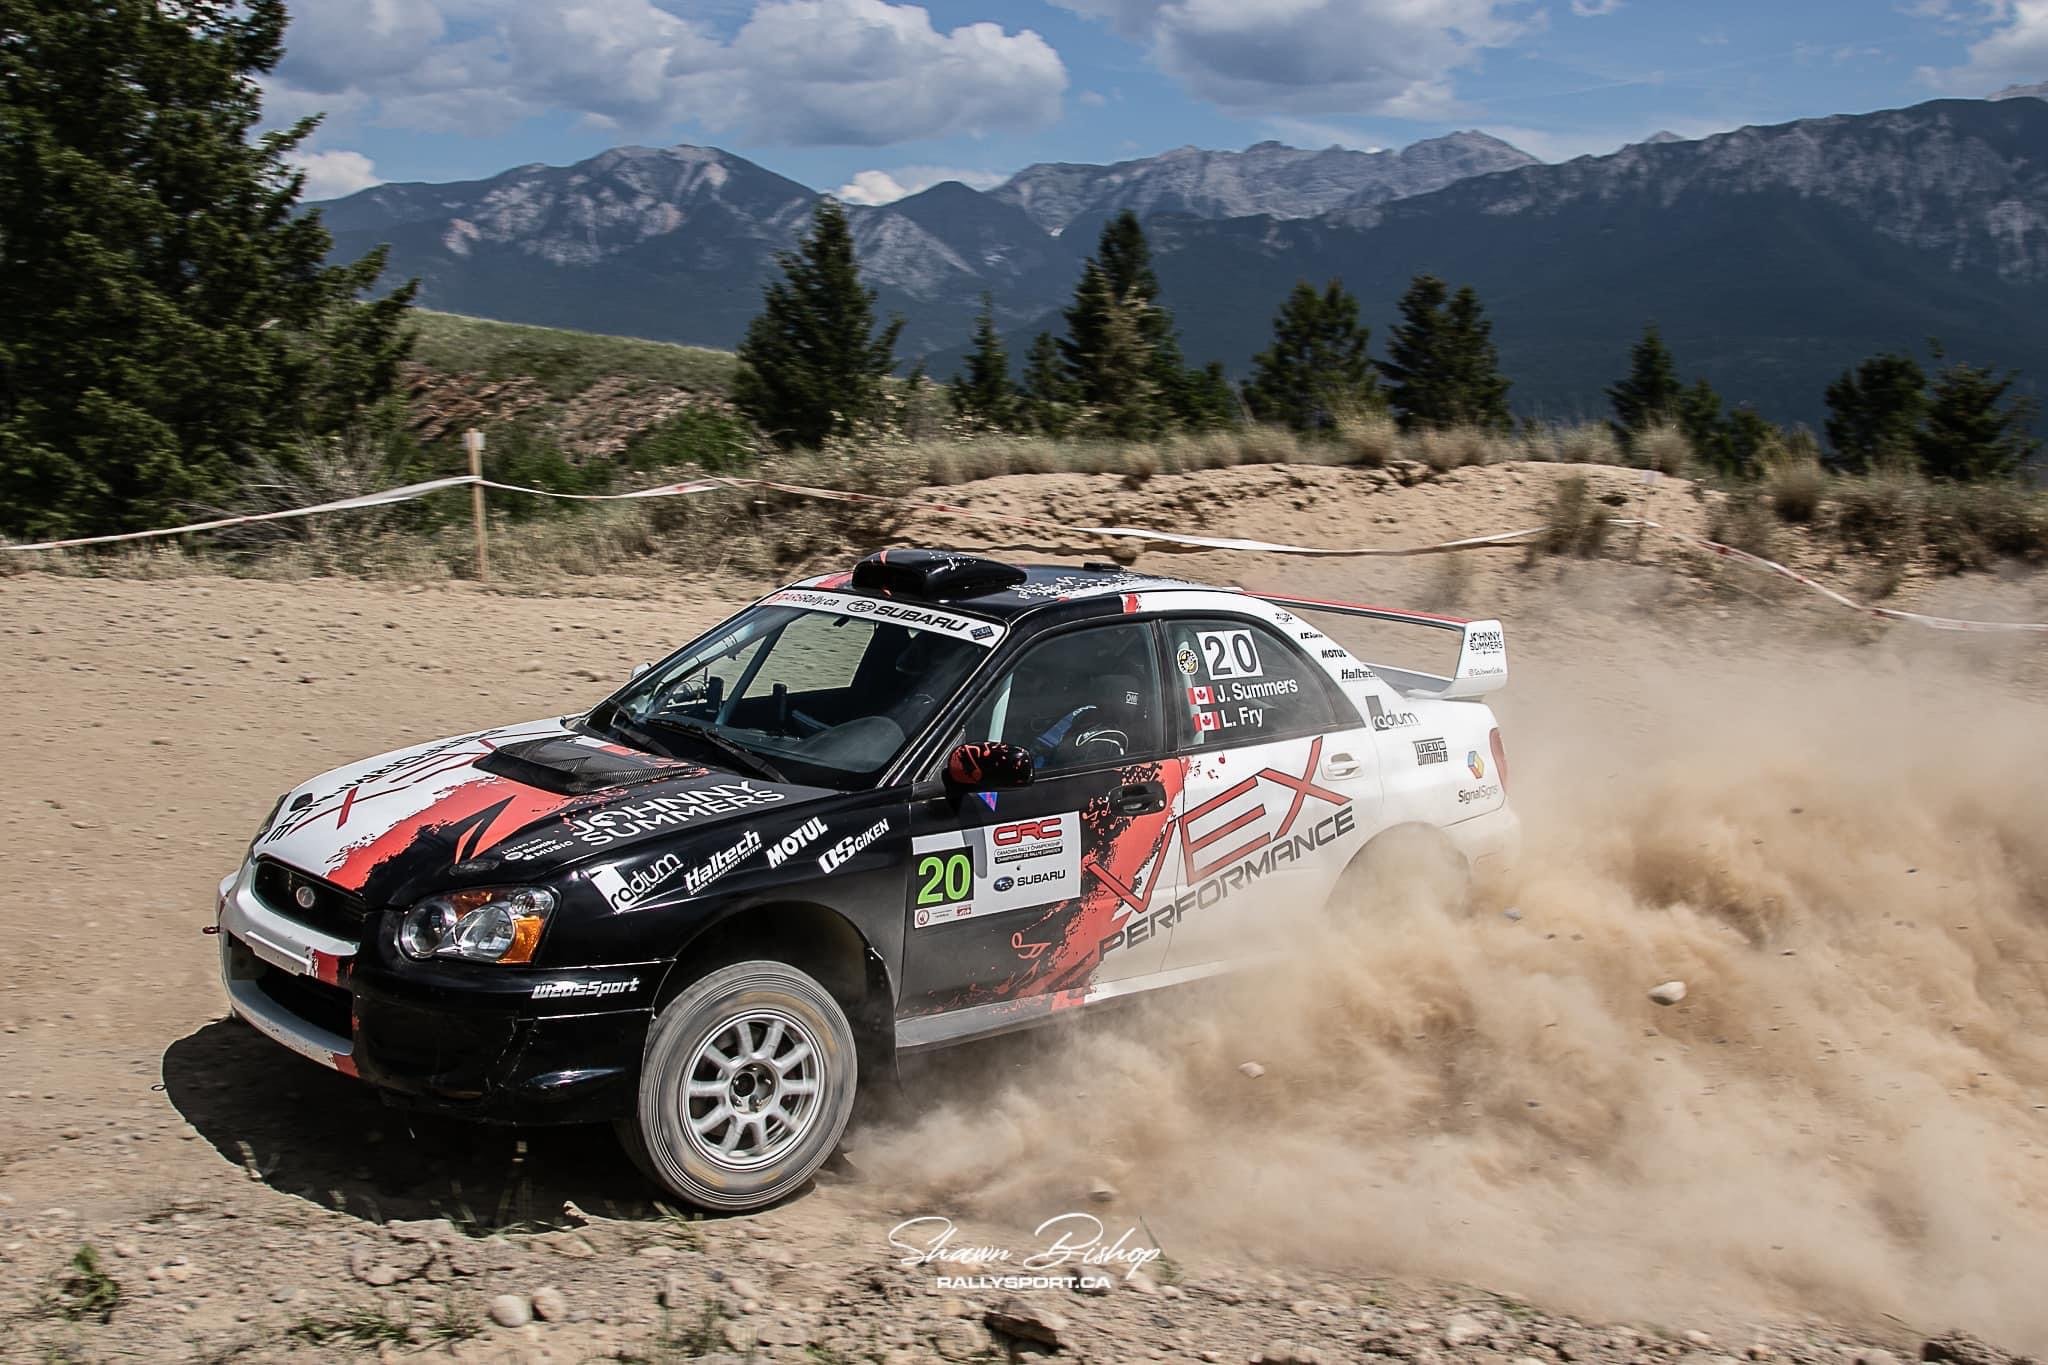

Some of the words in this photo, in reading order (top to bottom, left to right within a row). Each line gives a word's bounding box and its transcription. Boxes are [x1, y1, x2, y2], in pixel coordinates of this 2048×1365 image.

[874, 605, 969, 632] SUBARU
[1204, 633, 1258, 676] 20
[1321, 649, 1347, 658] MOTUL
[1470, 640, 1502, 650] SUMMERS
[1217, 685, 1230, 703] J.
[1231, 679, 1298, 701] Summers
[1341, 668, 1377, 679] Haltec
[1220, 709, 1236, 728] L.
[1239, 706, 1263, 727] Fry
[572, 780, 755, 837] JOHNNY
[581, 789, 785, 846] SUMMERS
[1085, 736, 1353, 914] VEX
[533, 840, 574, 857] MUSIC
[766, 816, 829, 870] MOTUL
[993, 818, 1062, 846] CRC
[683, 829, 762, 891] Haltech
[610, 853, 680, 910] radium
[917, 854, 971, 905] 20
[1017, 869, 1066, 887] SUBARU
[1099, 806, 1355, 962] PERFORMANCE
